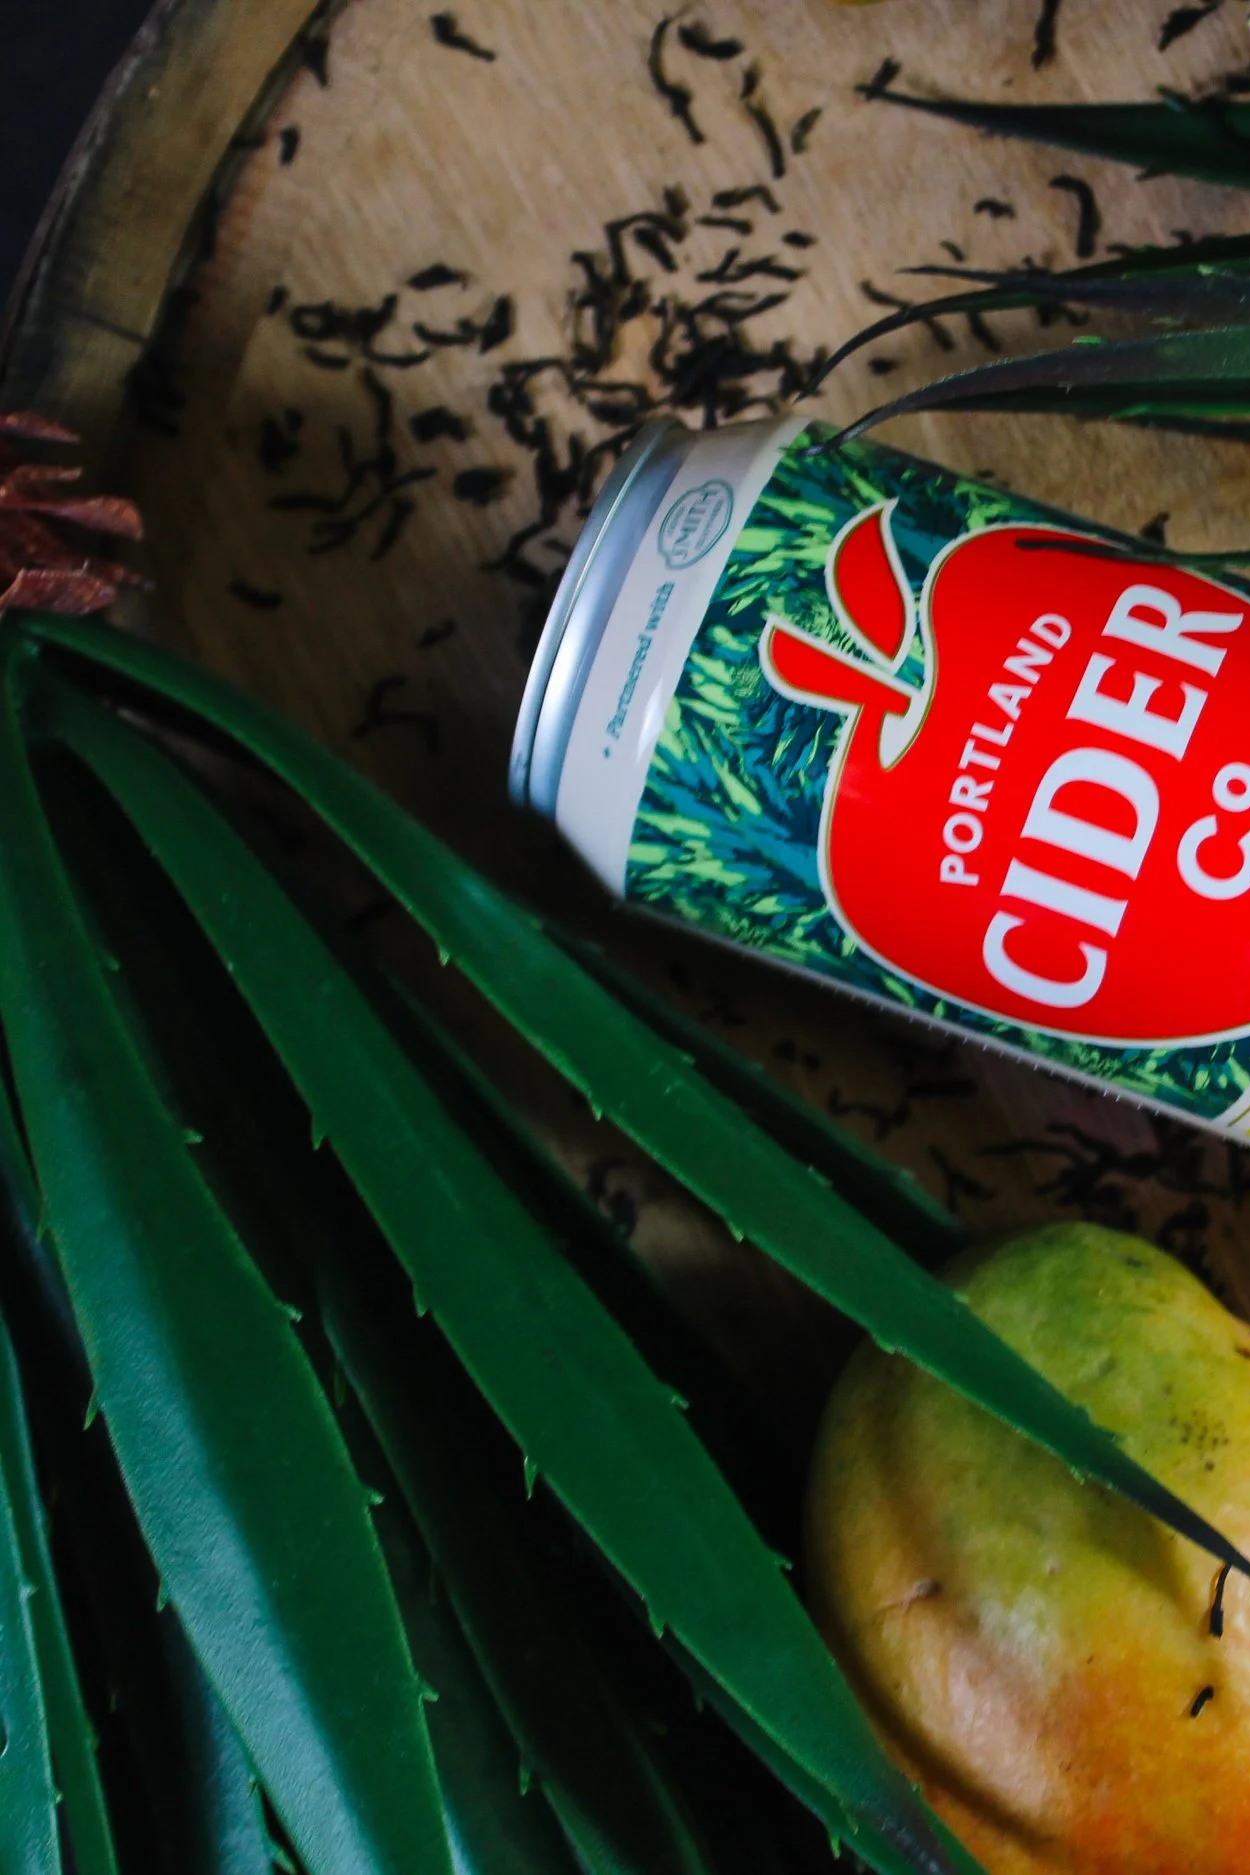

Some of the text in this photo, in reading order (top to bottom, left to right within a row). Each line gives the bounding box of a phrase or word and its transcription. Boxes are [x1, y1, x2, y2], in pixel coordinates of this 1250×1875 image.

[671, 488, 719, 560] SMITH
[606, 582, 676, 740] Partnered with
[939, 612, 1072, 886] PORTLAND
[982, 583, 1244, 1008] CIDER
